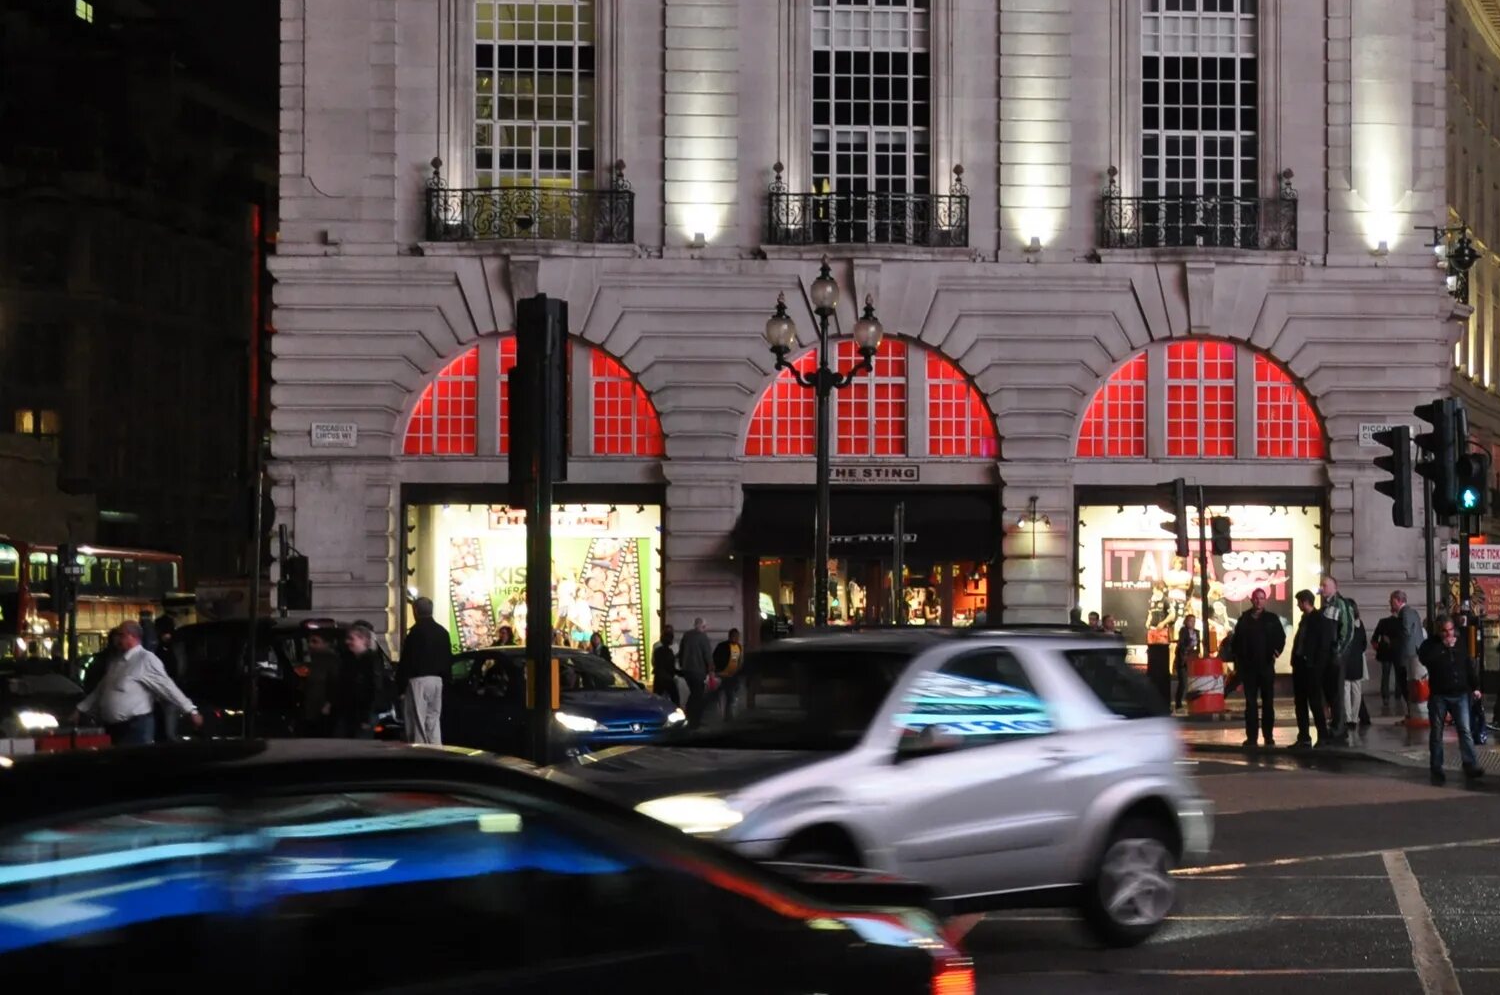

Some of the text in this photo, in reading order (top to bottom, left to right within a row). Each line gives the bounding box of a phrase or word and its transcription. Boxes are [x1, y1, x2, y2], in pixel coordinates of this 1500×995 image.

[862, 469, 915, 478] STING
[1469, 549, 1485, 559] RICE
[493, 566, 527, 585] KIS
